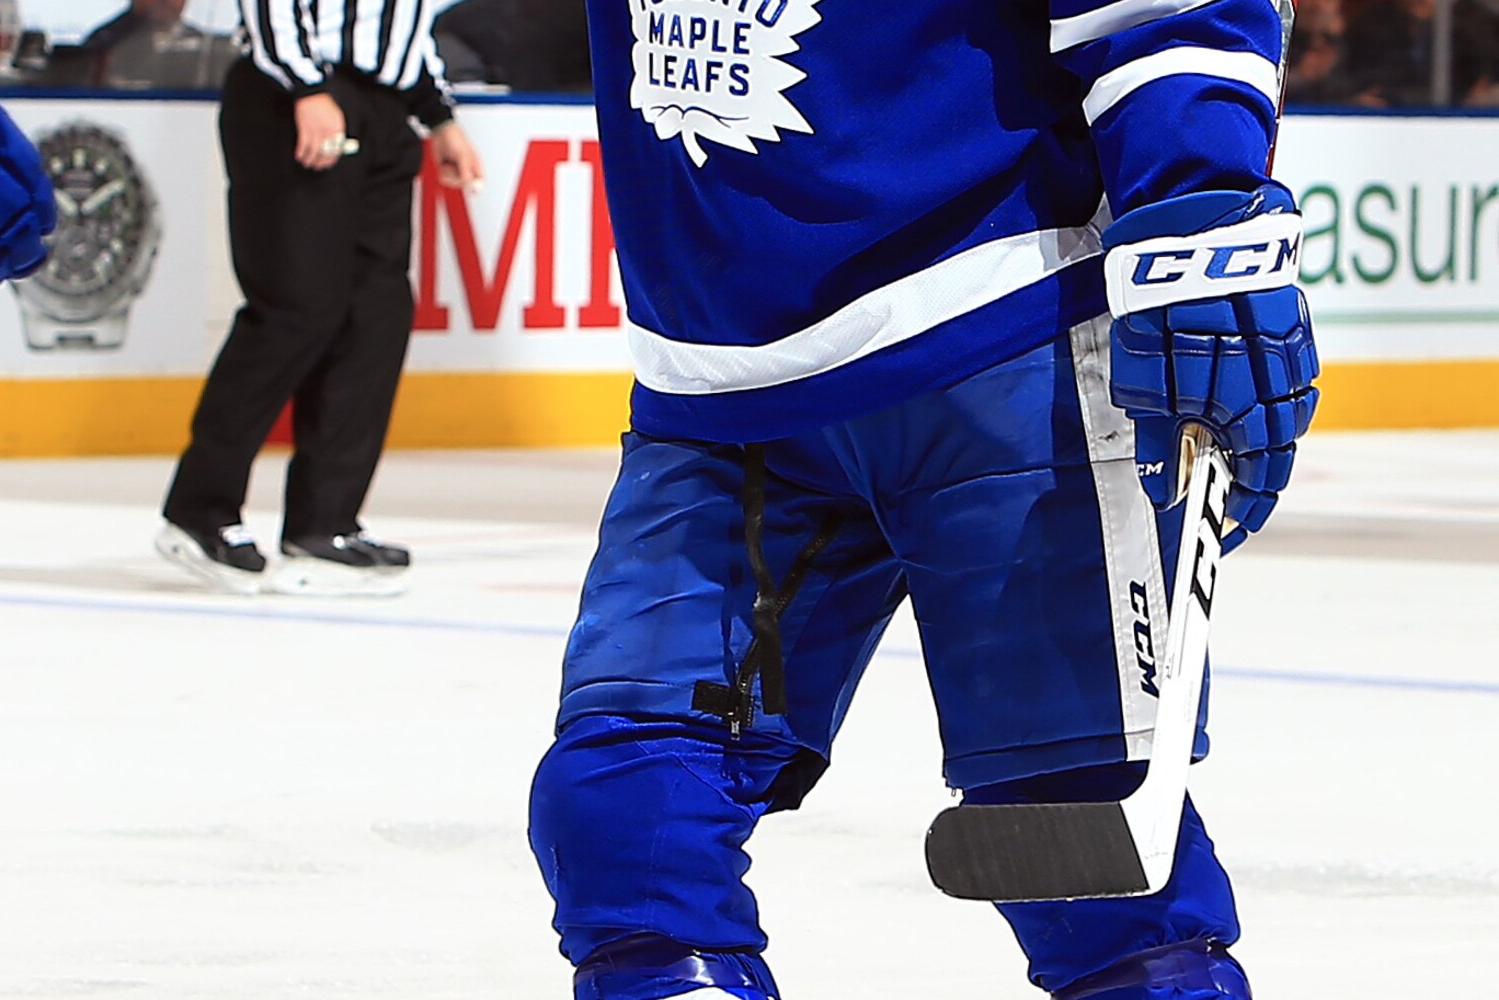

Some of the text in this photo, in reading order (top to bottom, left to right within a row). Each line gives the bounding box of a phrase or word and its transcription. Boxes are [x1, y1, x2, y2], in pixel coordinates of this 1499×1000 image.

[649, 10, 751, 54] MAPLE
[649, 52, 750, 96] LEAFS
[1132, 232, 1300, 285] CCM
[1129, 580, 1161, 699] CCM
